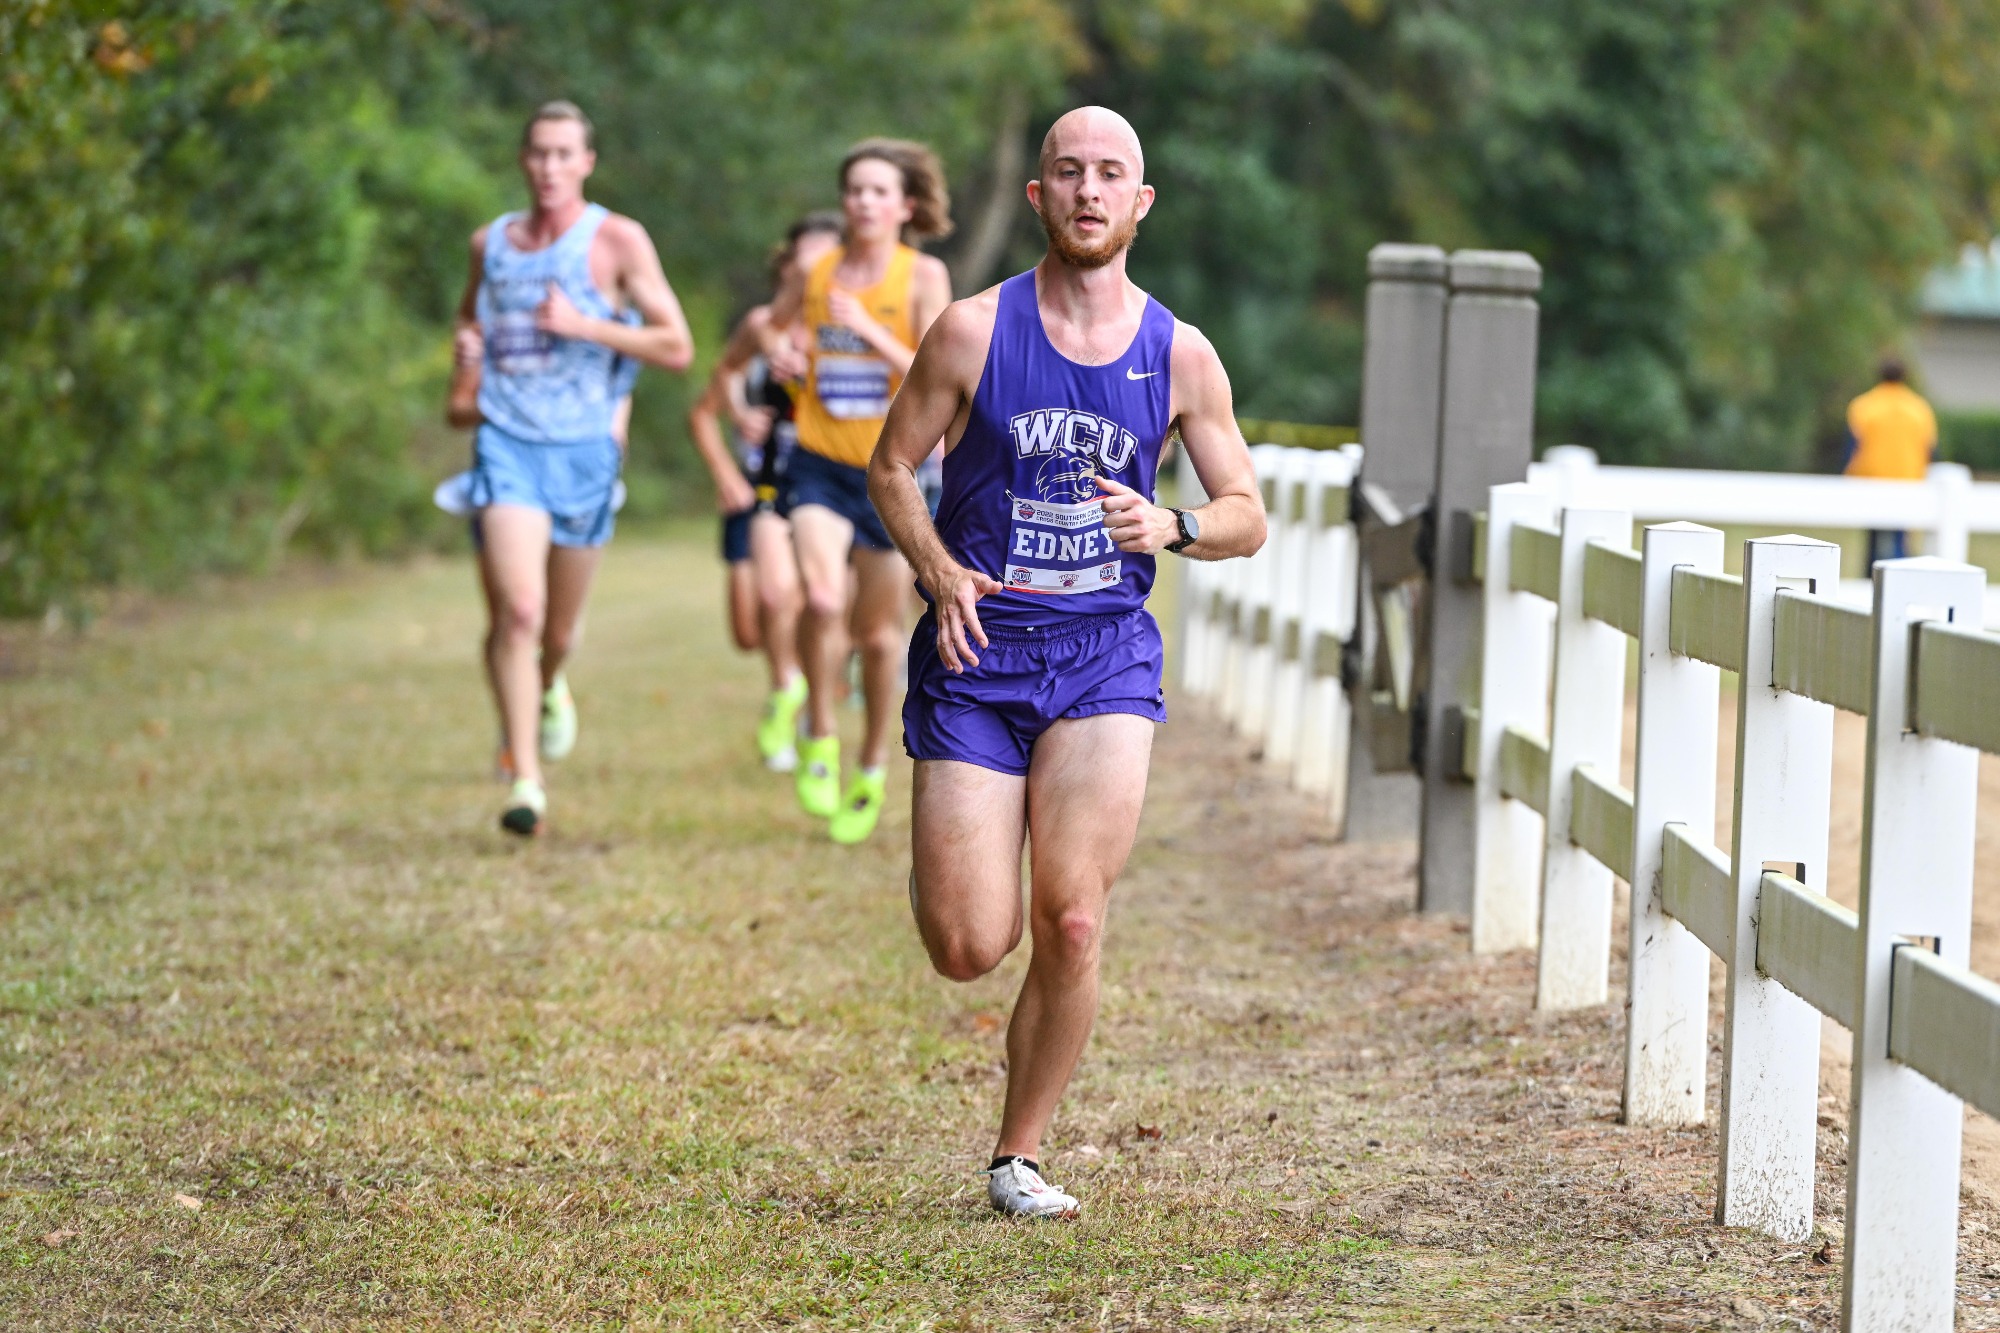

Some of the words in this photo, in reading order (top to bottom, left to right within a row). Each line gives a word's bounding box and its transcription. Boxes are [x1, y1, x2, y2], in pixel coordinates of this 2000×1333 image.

[1010, 408, 1138, 473] WCU
[1036, 509, 1054, 518] 2022
[1055, 512, 1087, 521] SOUTHERN
[1055, 519, 1079, 527] COUNTRY
[1013, 527, 1116, 562] EDNEY
